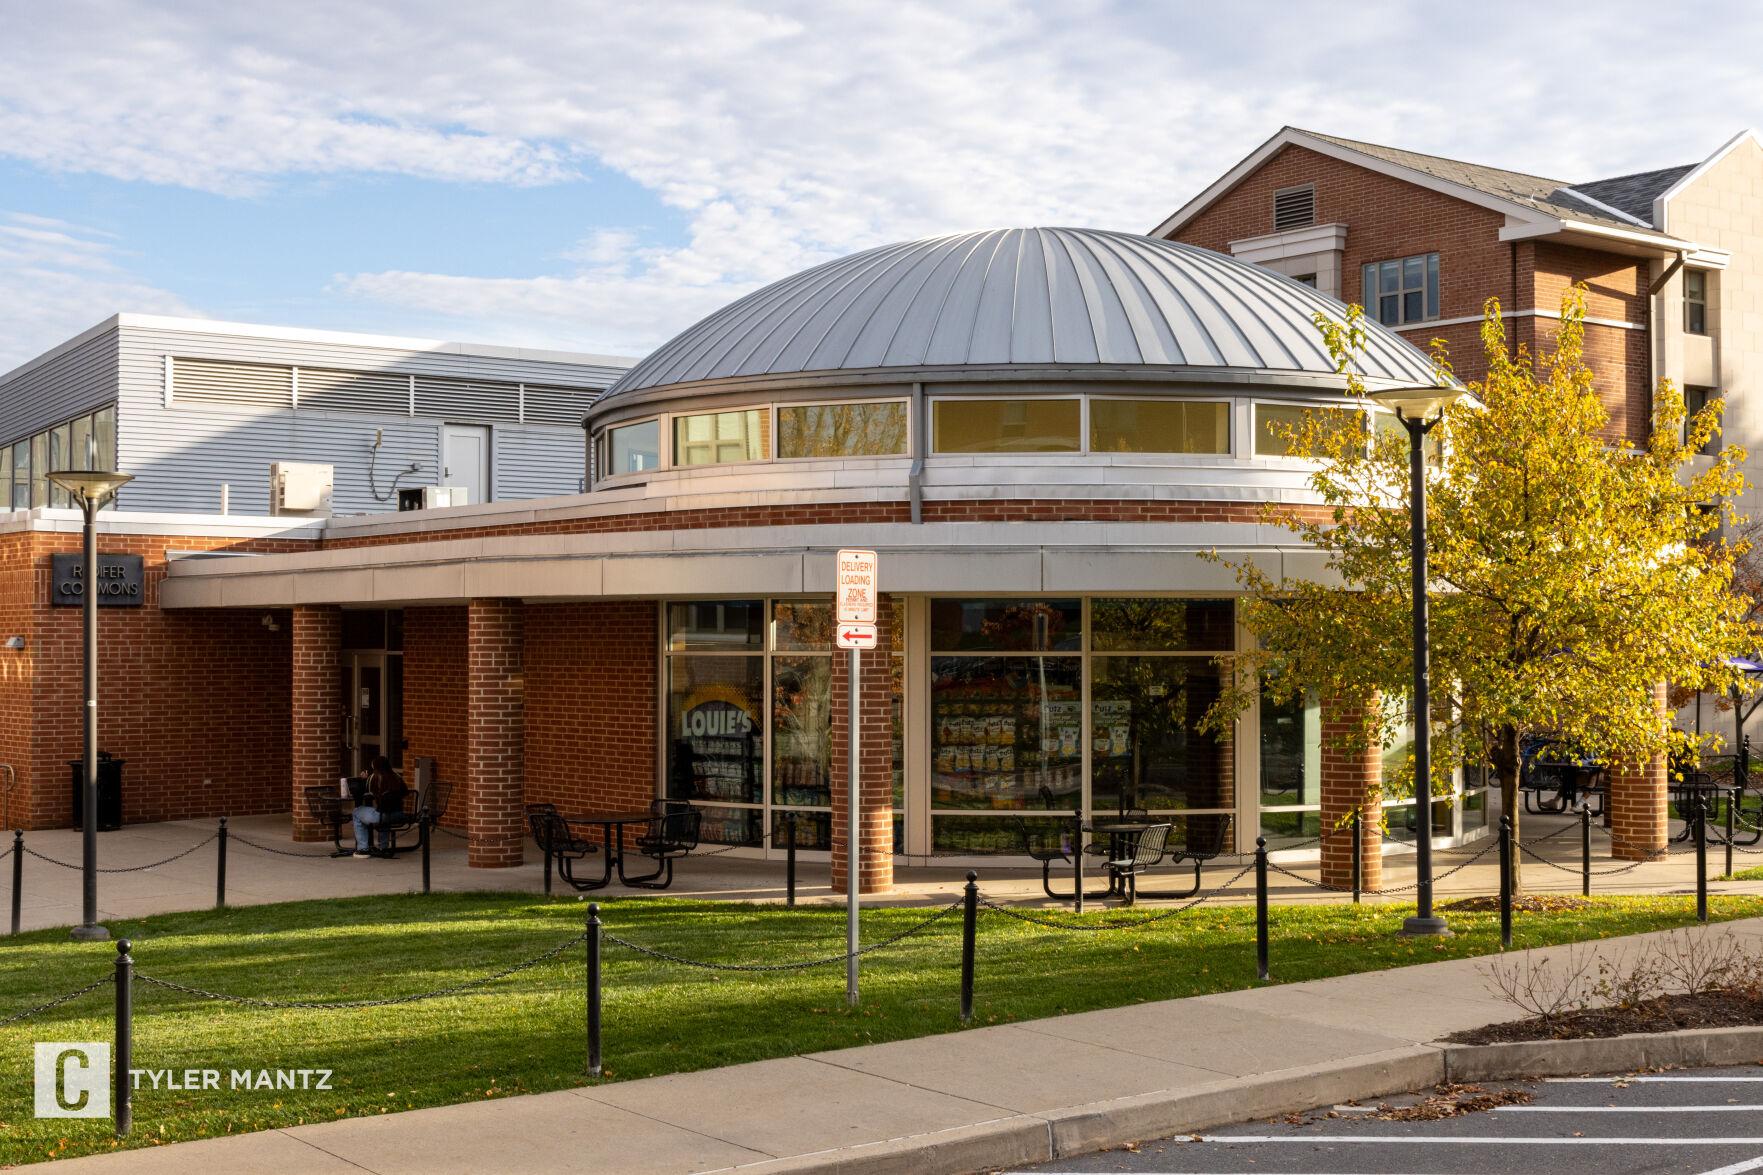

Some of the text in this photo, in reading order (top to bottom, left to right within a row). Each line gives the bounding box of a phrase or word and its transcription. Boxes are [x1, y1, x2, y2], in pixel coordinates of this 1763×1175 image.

[73, 564, 126, 578] RIFER
[841, 561, 873, 572] DELIVERY
[841, 574, 871, 586] LOADING
[60, 581, 138, 595] COMONS
[847, 588, 867, 598] ZONE
[681, 709, 752, 737] LOUIE'S
